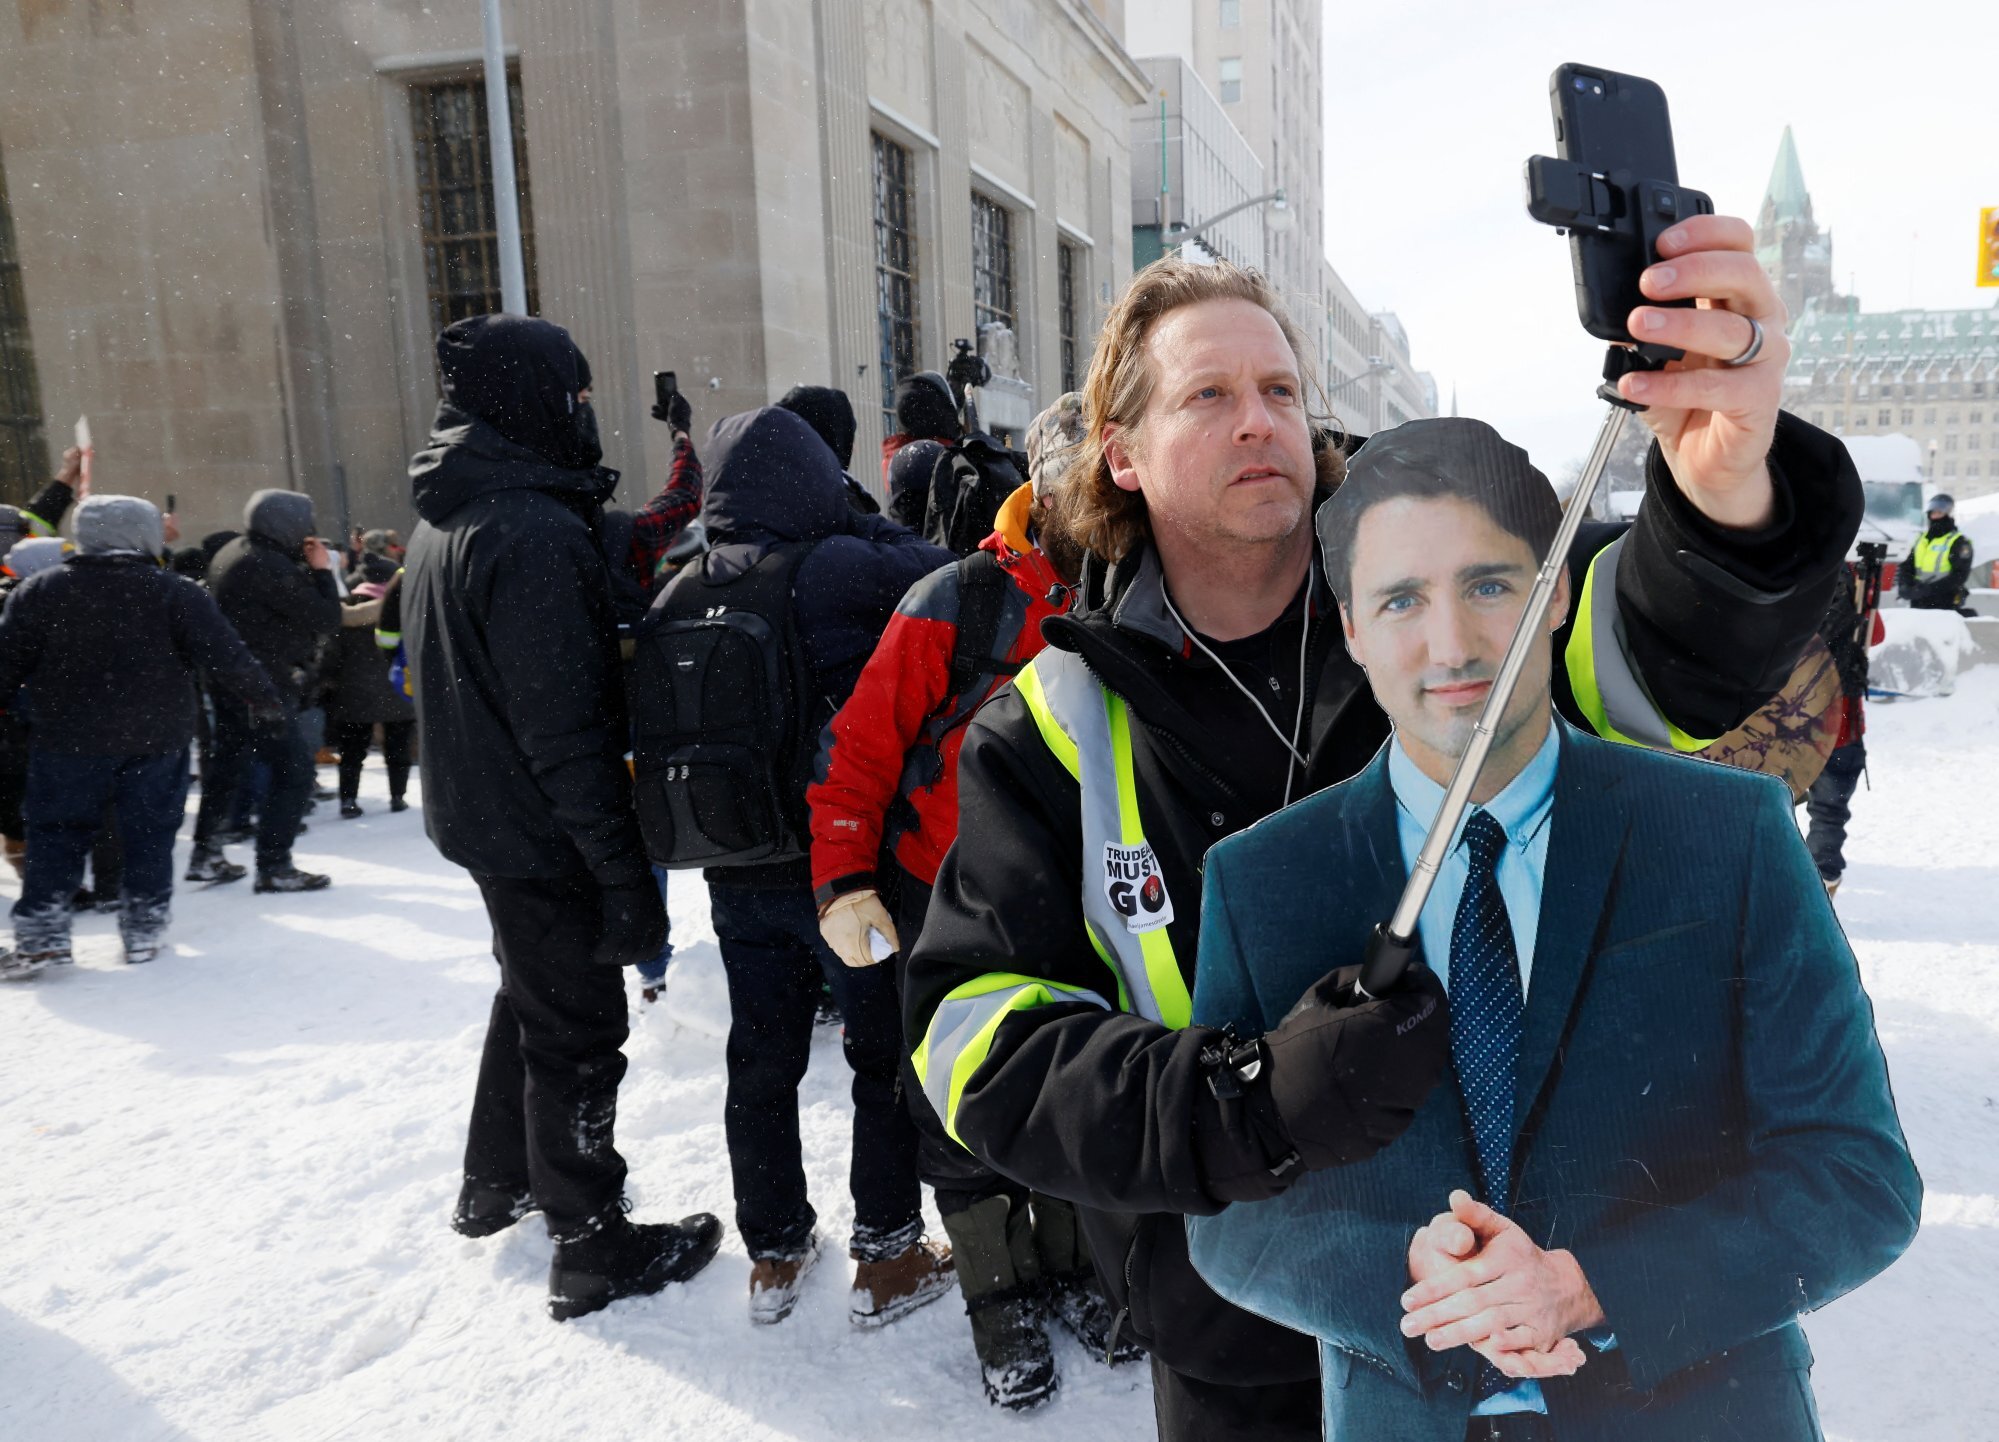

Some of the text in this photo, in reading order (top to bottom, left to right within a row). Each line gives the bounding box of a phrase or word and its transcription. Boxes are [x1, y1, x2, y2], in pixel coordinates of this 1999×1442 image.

[1106, 844, 1153, 862] TRUDEA
[1106, 853, 1157, 880] MUST
[1109, 881, 1166, 917] GO
[1396, 998, 1437, 1036] KOMBI
